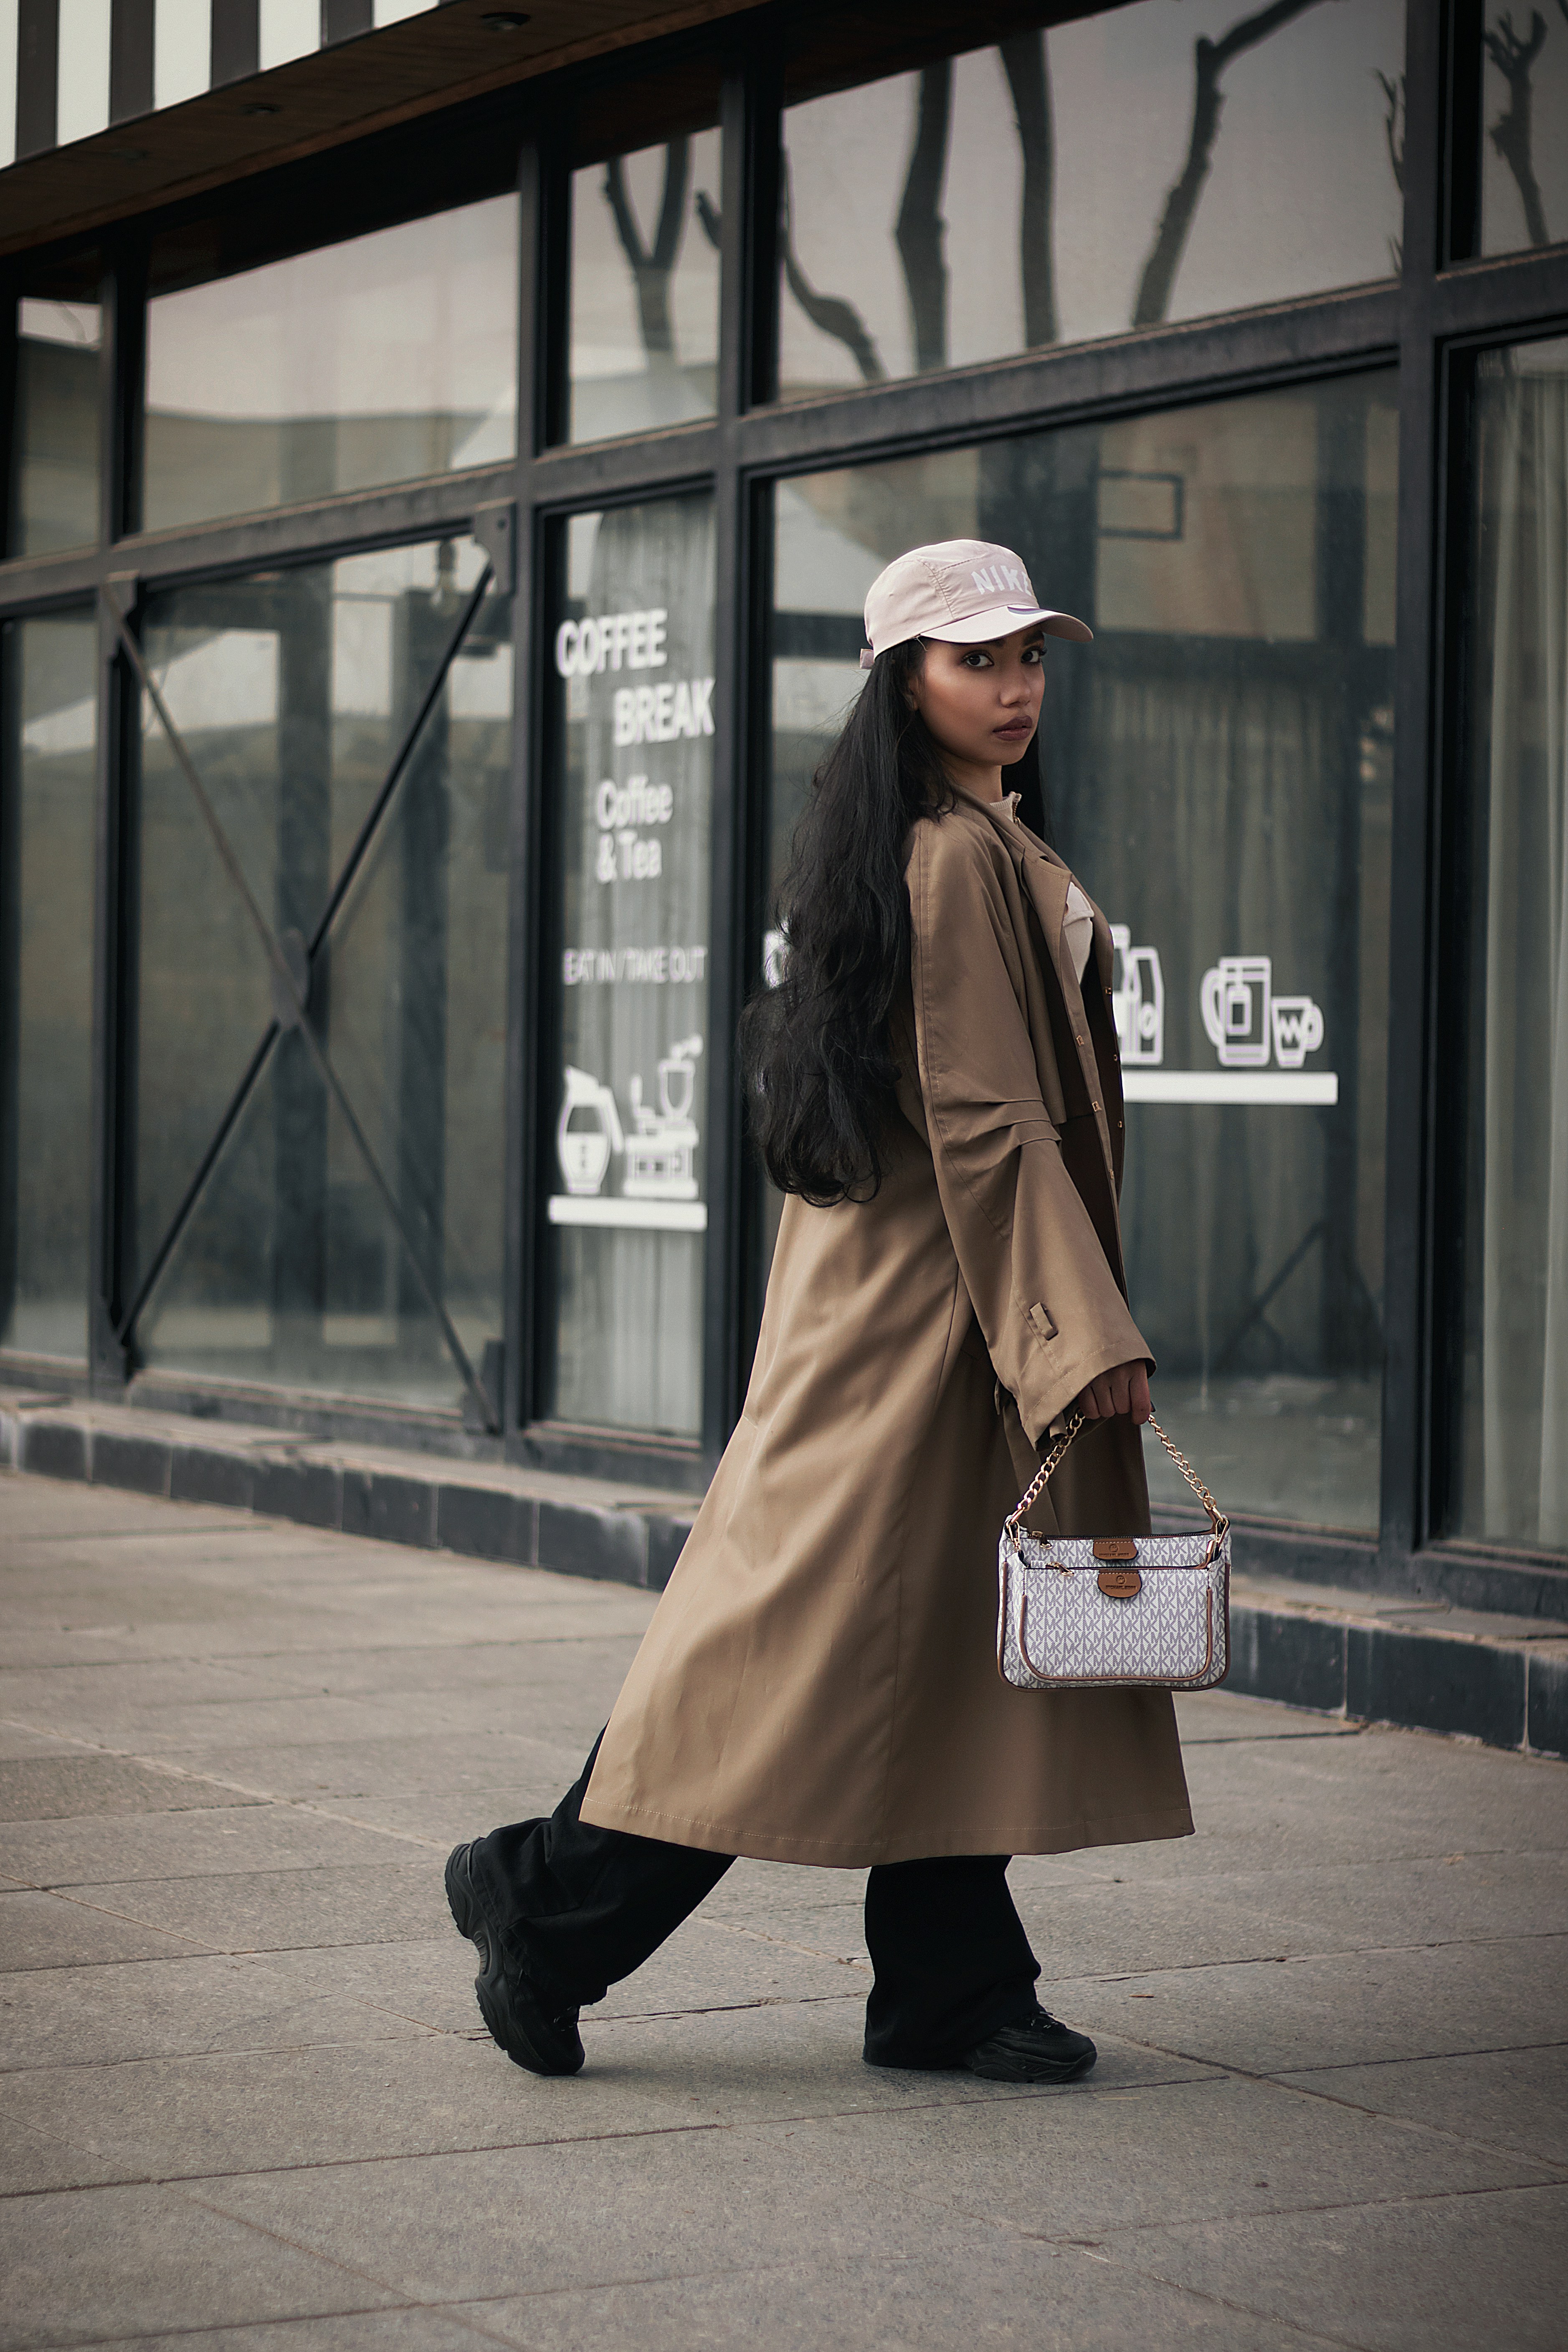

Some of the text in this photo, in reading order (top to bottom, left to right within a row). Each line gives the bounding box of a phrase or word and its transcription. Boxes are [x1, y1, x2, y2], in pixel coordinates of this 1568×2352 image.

[557, 608, 667, 677] COFFEE
[613, 677, 715, 747] BREAK
[597, 775, 673, 828] Coffee
[597, 829, 662, 882] & Tea
[562, 948, 594, 985] EAT
[669, 945, 708, 983] OUT
